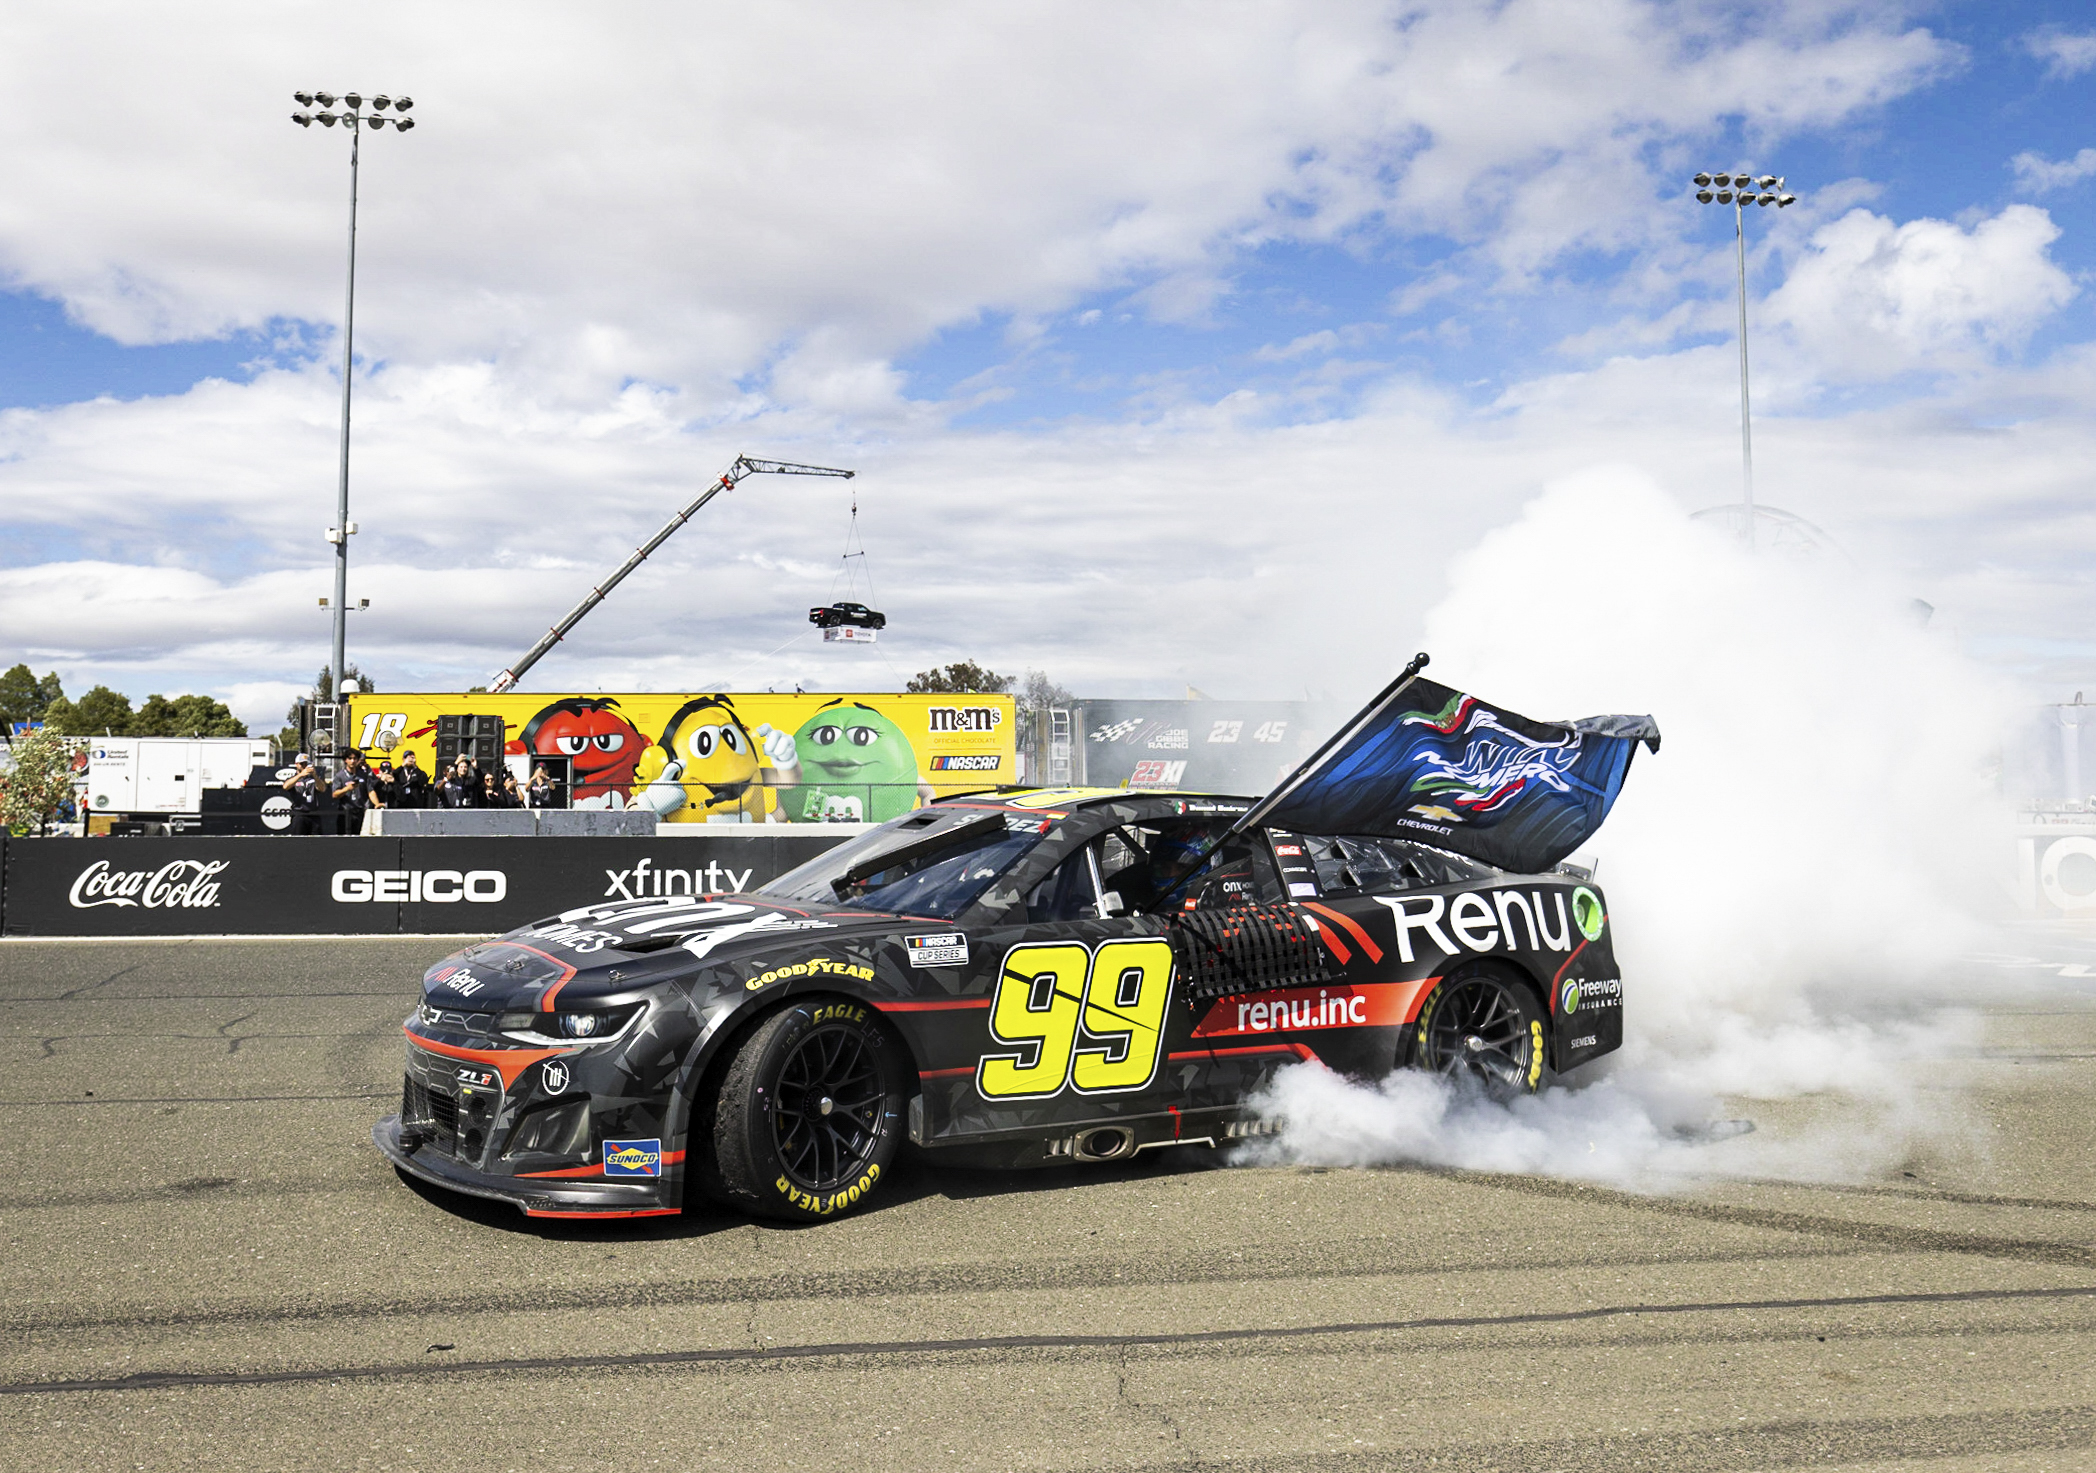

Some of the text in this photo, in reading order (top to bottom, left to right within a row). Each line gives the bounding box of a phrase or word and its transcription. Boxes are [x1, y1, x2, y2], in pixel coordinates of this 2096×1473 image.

[358, 713, 408, 749] 18
[1166, 728, 1189, 736] JOE
[1207, 720, 1288, 743] 23 45
[1147, 741, 1189, 749] RACING
[946, 756, 998, 770] NASCAR
[1129, 760, 1188, 784] 23XI
[1397, 818, 1454, 837] CHEVROLET
[69, 859, 230, 908] Coca-Cola
[331, 870, 507, 903] GEICO
[604, 857, 753, 900] xfinity
[1372, 890, 1572, 964] Renu
[925, 936, 958, 947] NASCAR
[917, 949, 960, 961] CUP SERIES
[443, 968, 486, 998] Renu
[745, 958, 876, 991] GOODYEAR
[1578, 978, 1622, 998] Freeway
[812, 1003, 867, 1026] EAGLE
[1238, 990, 1367, 1031] renu.inc
[1578, 997, 1623, 1011] INSURANCE
[976, 937, 1177, 1102] 99
[1571, 1035, 1598, 1050] SIEMENS
[457, 1069, 493, 1086] ZL1
[608, 1153, 658, 1165] SUNOCO
[775, 1163, 881, 1215] GOODYEAR
